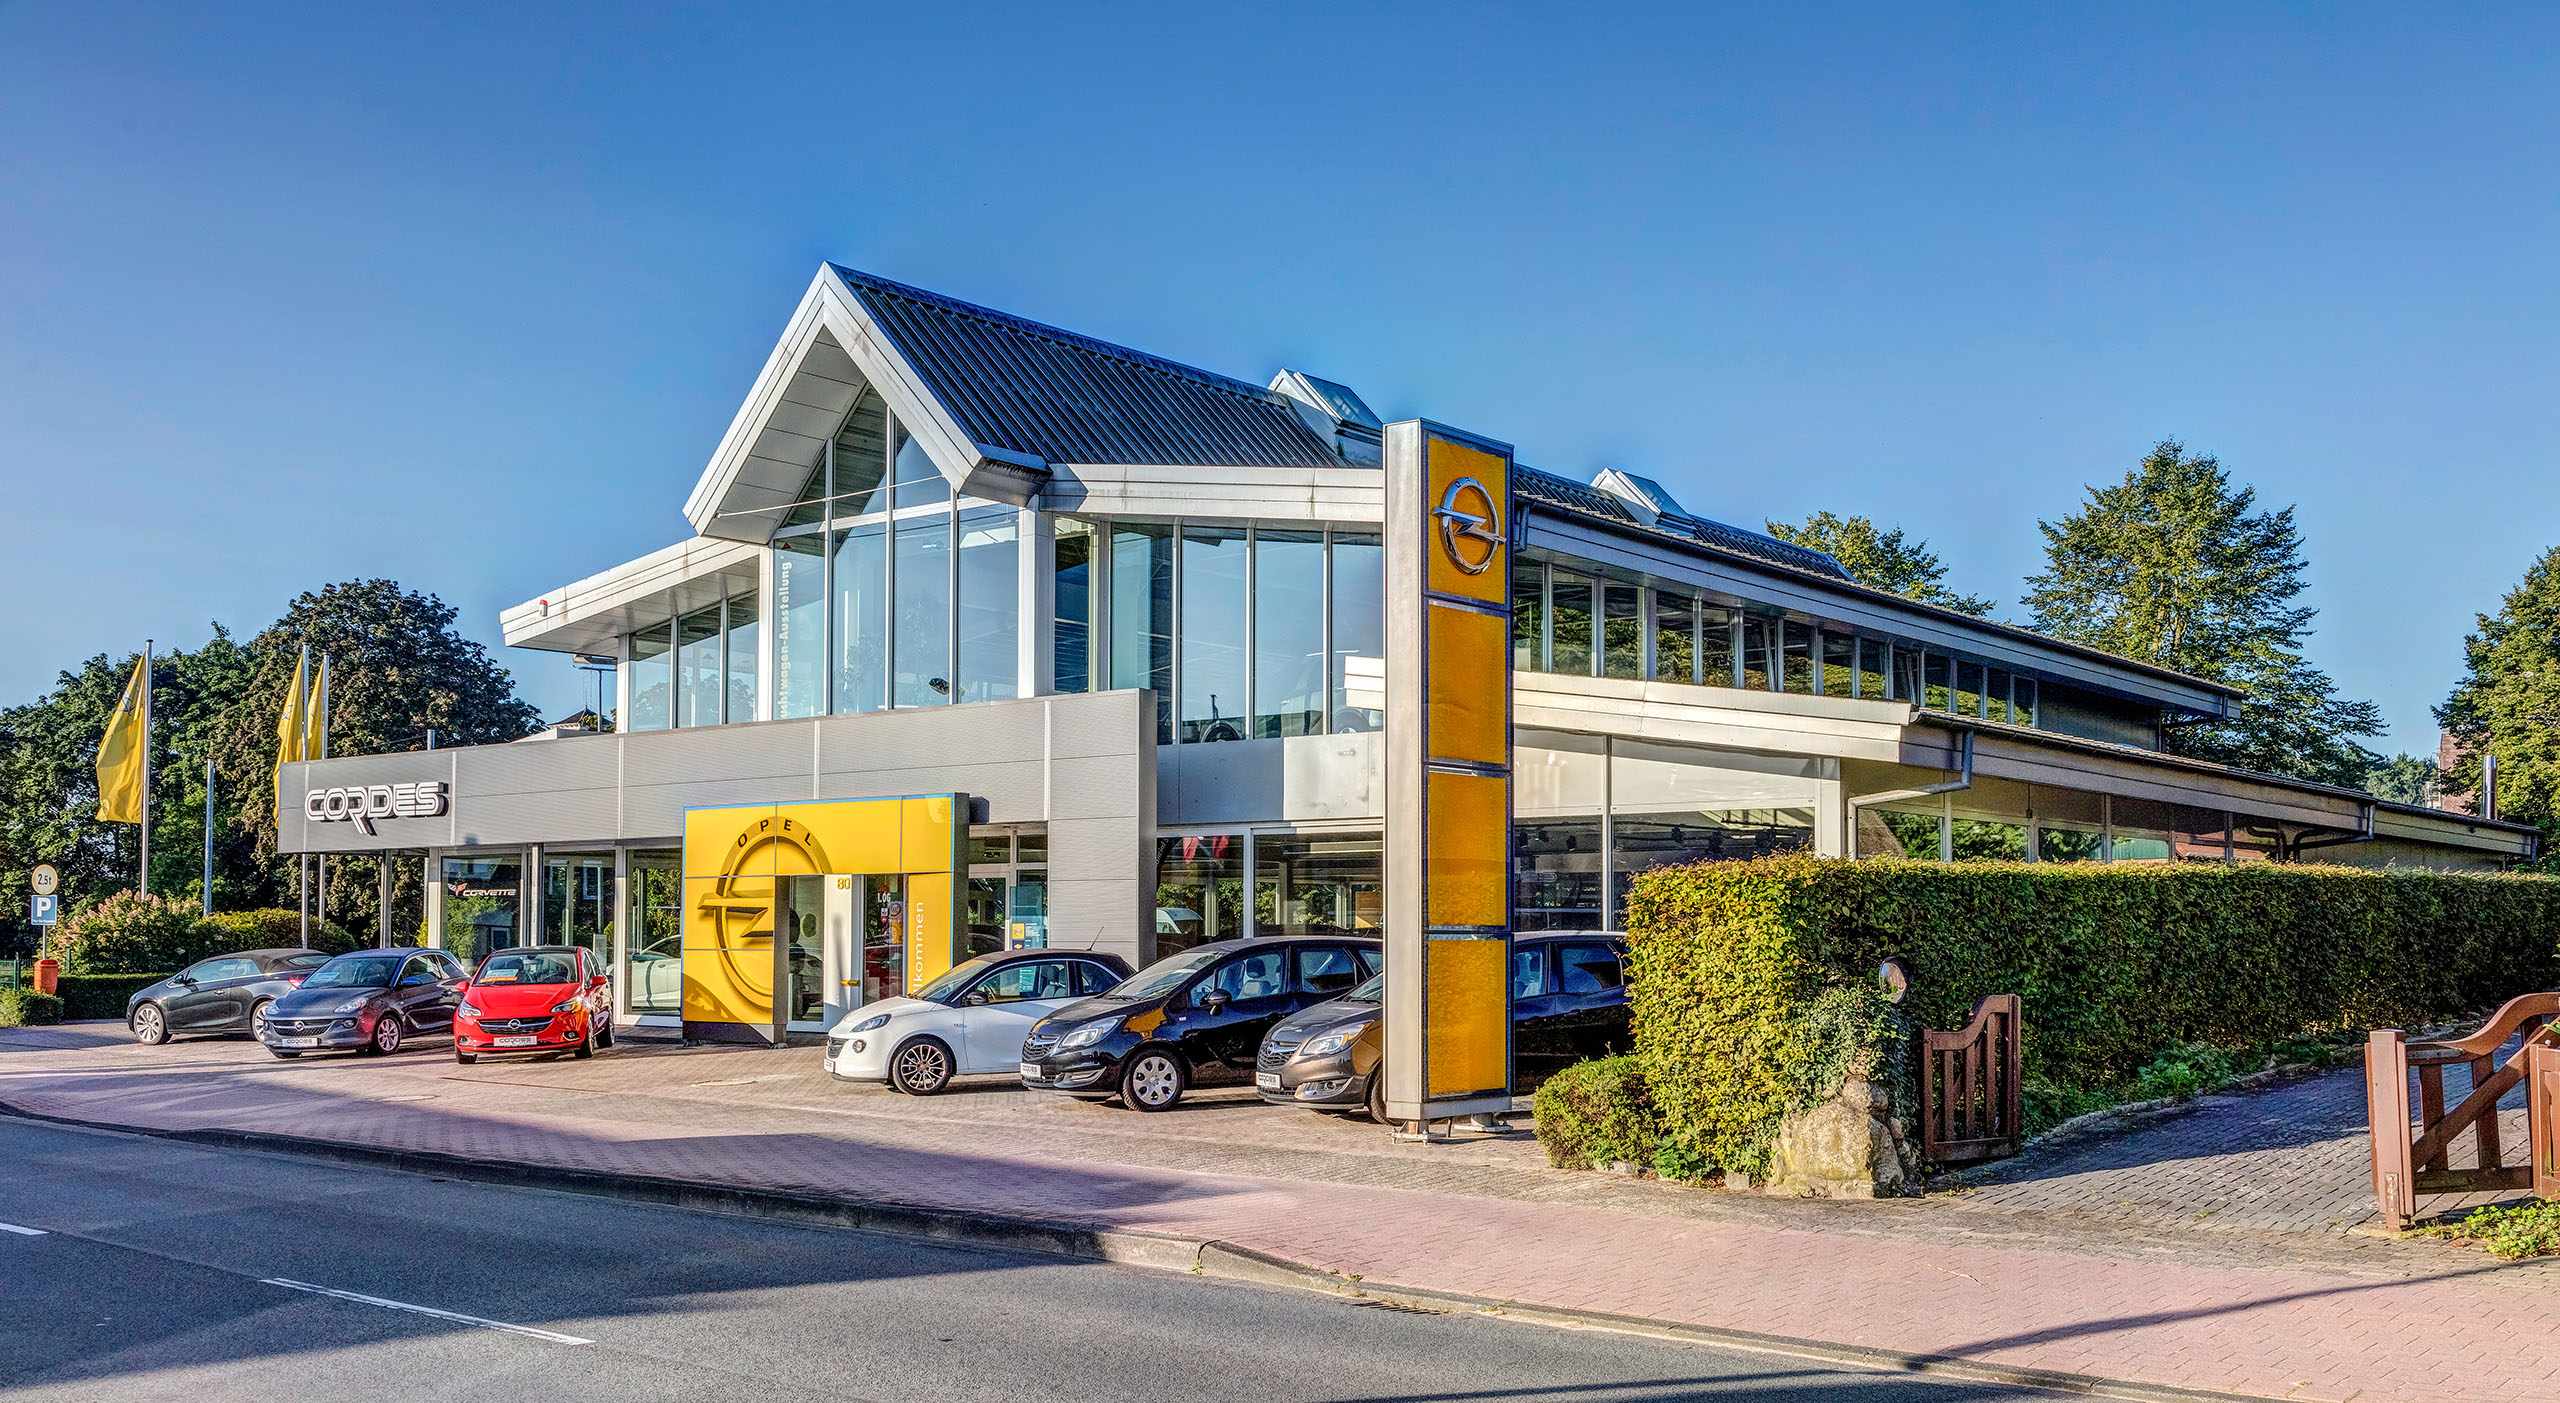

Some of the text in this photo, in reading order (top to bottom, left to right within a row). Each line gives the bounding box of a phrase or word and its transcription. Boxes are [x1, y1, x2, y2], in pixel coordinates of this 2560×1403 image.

[305, 781, 446, 836] CORDES
[737, 818, 812, 848] OPEL
[462, 888, 518, 897] CORVETTE
[837, 878, 850, 889] 80
[36, 897, 52, 918] P
